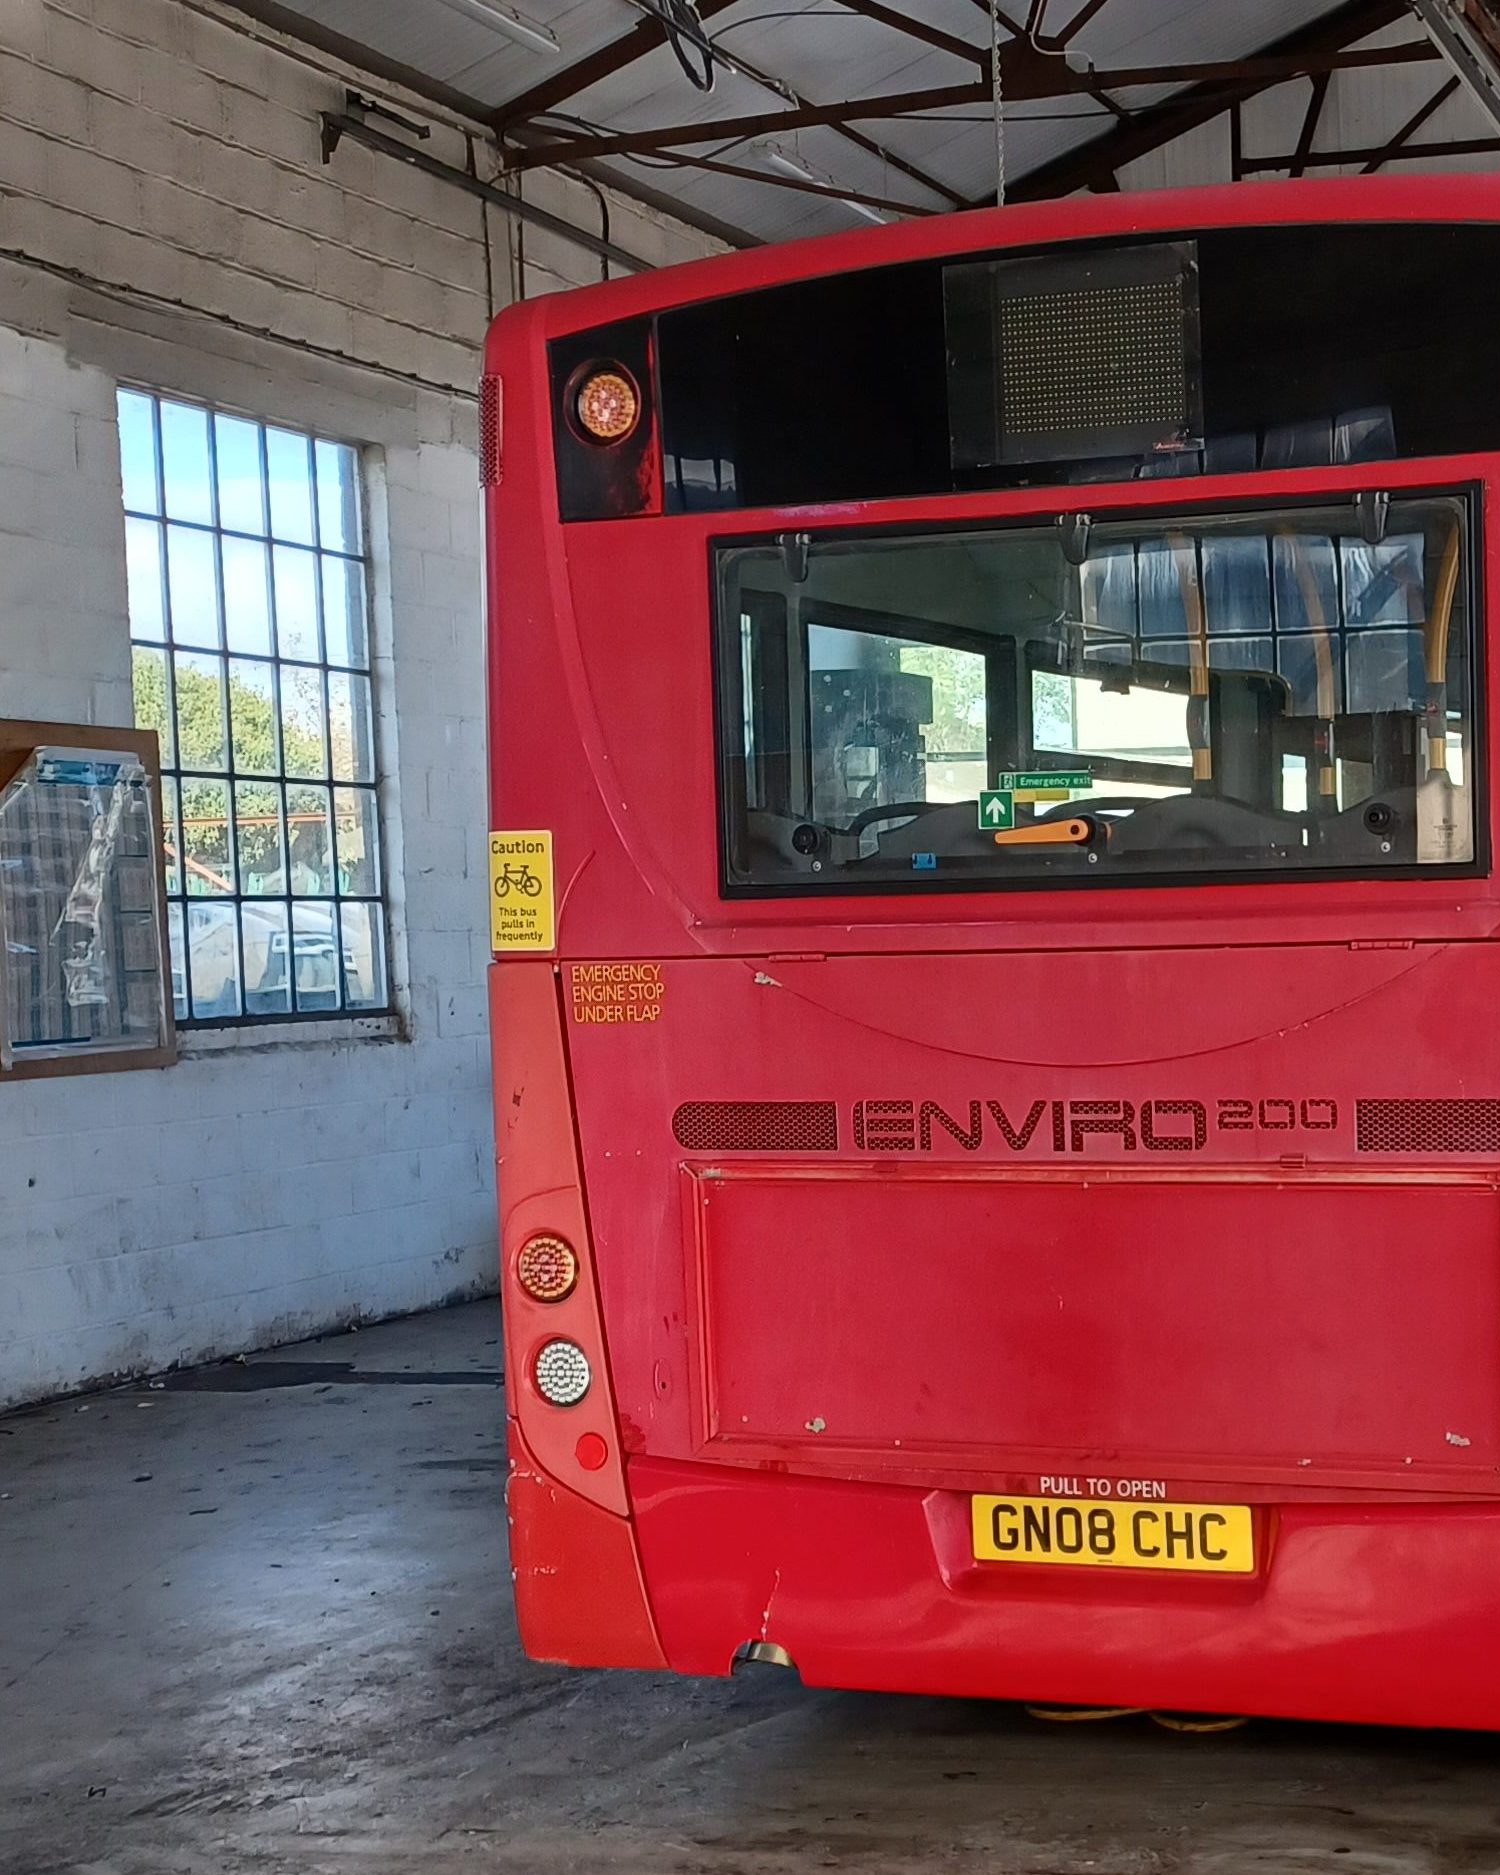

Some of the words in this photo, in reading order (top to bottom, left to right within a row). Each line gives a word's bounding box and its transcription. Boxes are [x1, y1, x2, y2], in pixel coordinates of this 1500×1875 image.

[1020, 776, 1070, 787] Emergency
[1073, 776, 1091, 785] exit
[491, 840, 545, 854] Caution
[499, 907, 518, 917] This
[520, 907, 537, 917] bus
[501, 919, 524, 930] pulls
[526, 919, 535, 929] in
[496, 931, 543, 942] frequently
[572, 964, 662, 983] EMERGENCY
[572, 985, 626, 1003] ENGINE
[628, 983, 665, 1001] STOP
[573, 1005, 624, 1024] UNDER
[626, 1004, 661, 1021] FLAP
[852, 1100, 1208, 1153] ENVIRO
[1216, 1097, 1338, 1132] 200
[1039, 1476, 1083, 1496] PULL
[1086, 1478, 1111, 1497] TO
[1117, 1479, 1167, 1499] OPEN
[991, 1503, 1116, 1556] GN08
[1131, 1510, 1228, 1562] CHC
